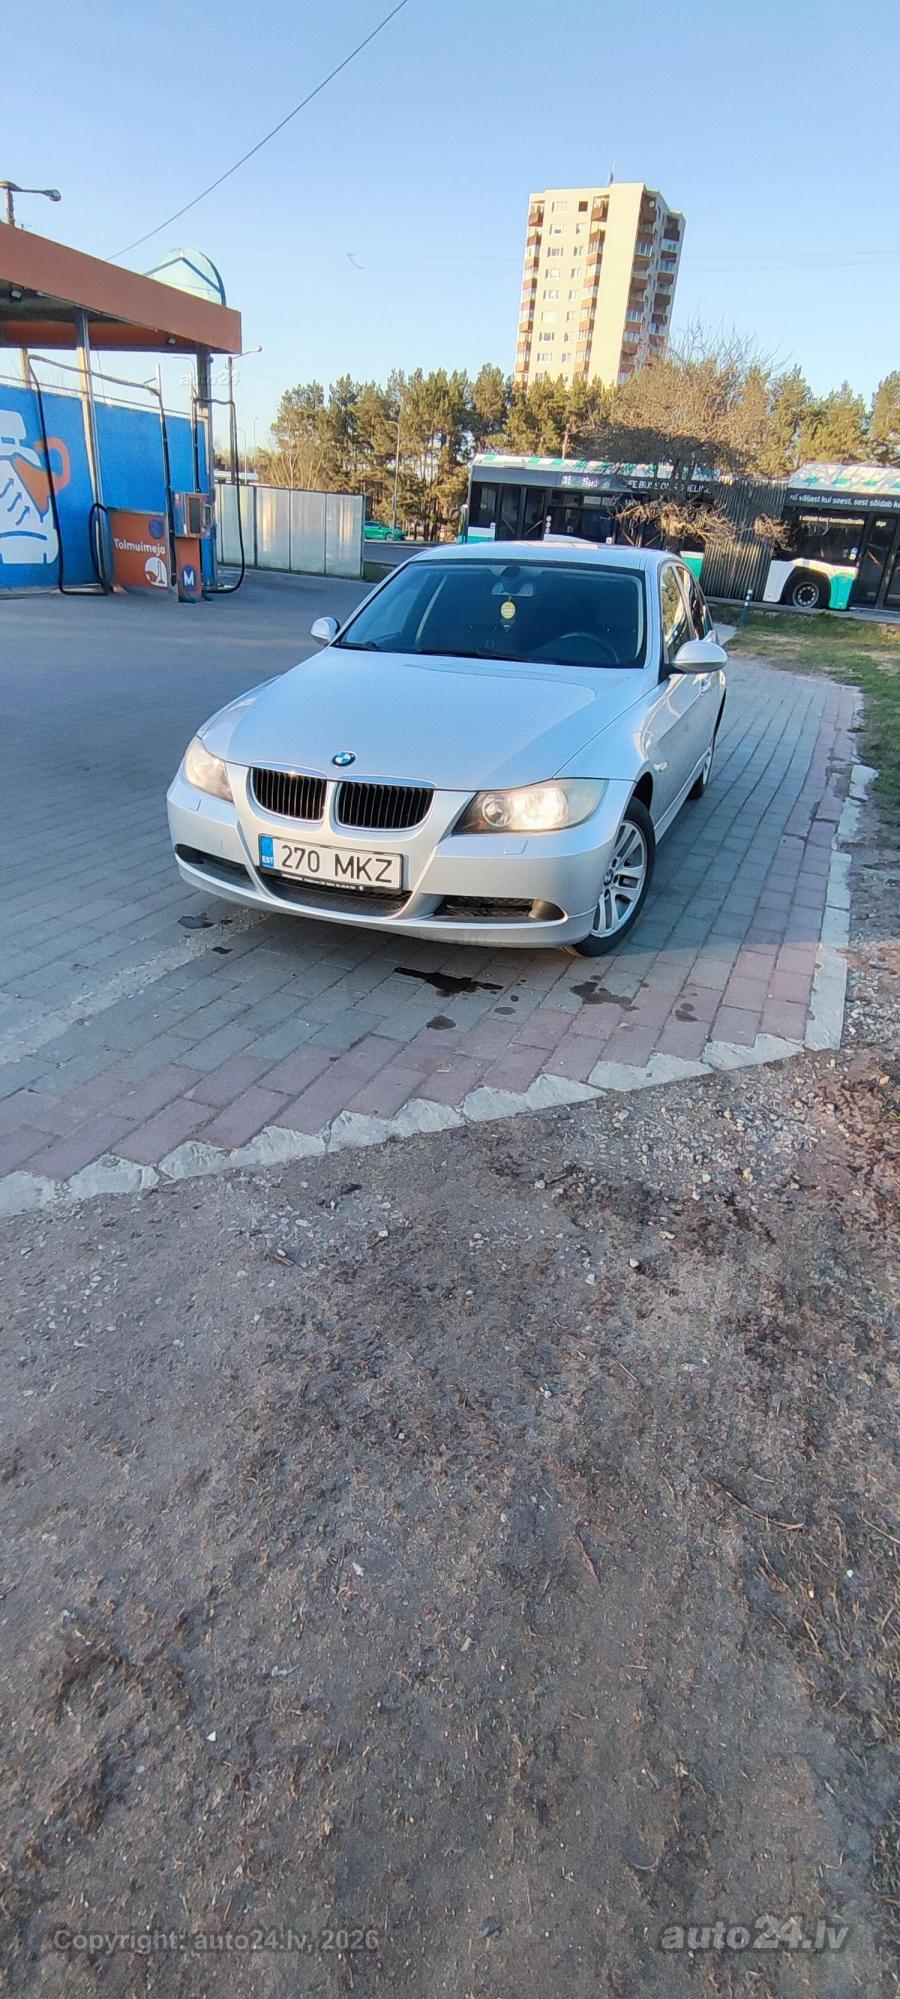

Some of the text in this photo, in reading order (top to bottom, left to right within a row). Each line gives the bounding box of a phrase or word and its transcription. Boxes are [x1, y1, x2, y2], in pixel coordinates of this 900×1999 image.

[821, 496, 833, 504] kui
[113, 537, 166, 556] Tolmuimeja
[183, 570, 195, 586] M
[262, 855, 273, 864] EST
[281, 844, 320, 873] 270
[334, 853, 393, 883] MKZ
